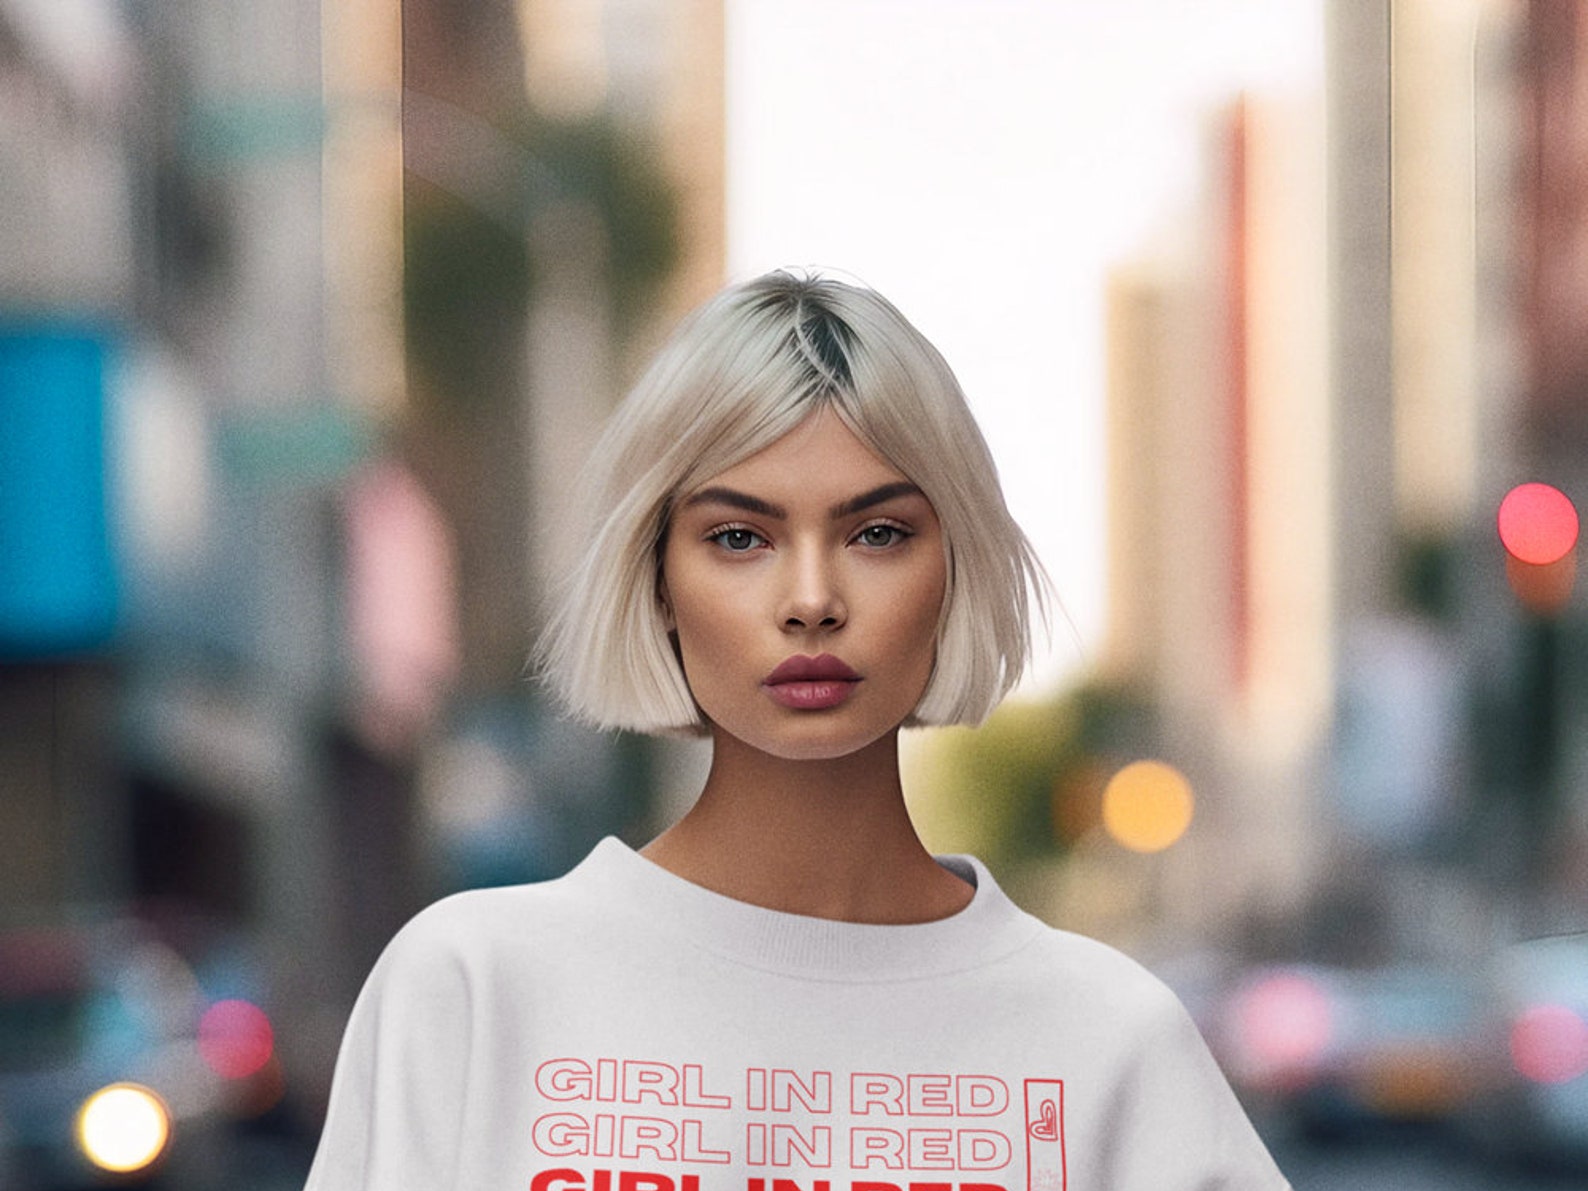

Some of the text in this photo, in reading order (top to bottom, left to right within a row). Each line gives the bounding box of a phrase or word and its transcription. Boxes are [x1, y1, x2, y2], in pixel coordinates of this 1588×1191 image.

[535, 1058, 1010, 1117] GIRL IN RED
[532, 1112, 1012, 1171] GIRL IN RED
